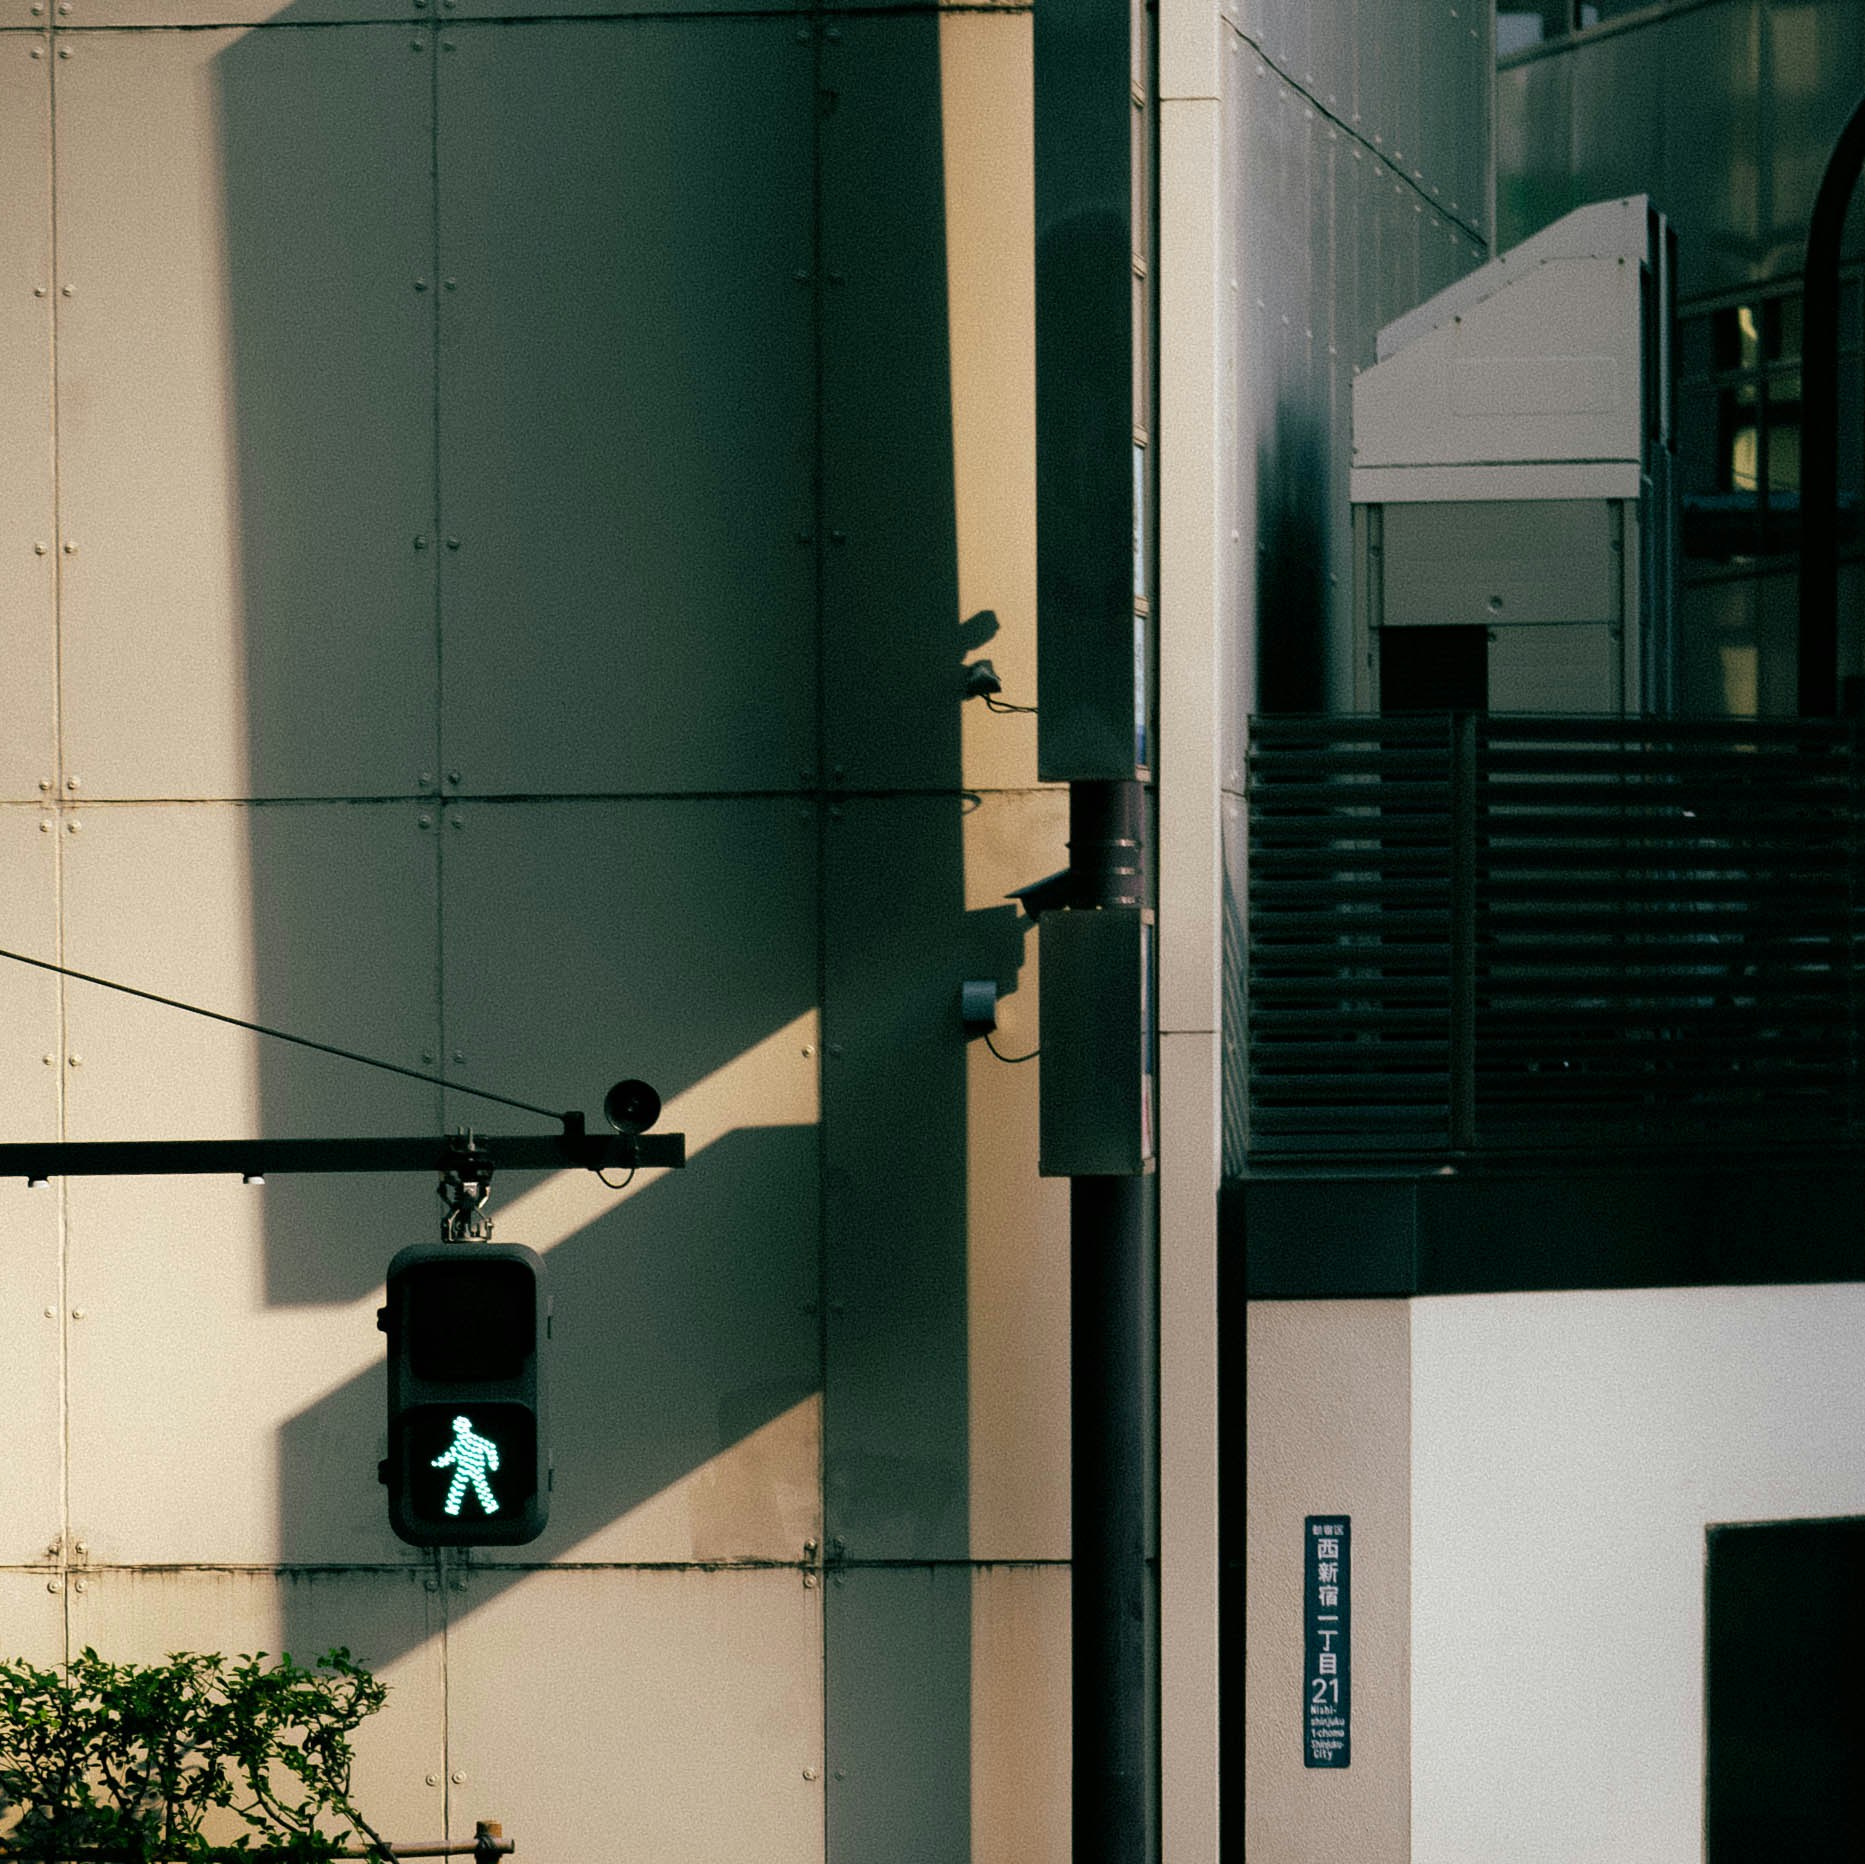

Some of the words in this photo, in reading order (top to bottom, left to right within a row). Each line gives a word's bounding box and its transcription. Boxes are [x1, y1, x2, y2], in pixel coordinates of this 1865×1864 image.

[1317, 1538, 1340, 1675] 西新宿一丁目
[1312, 1678, 1339, 1704] 21
